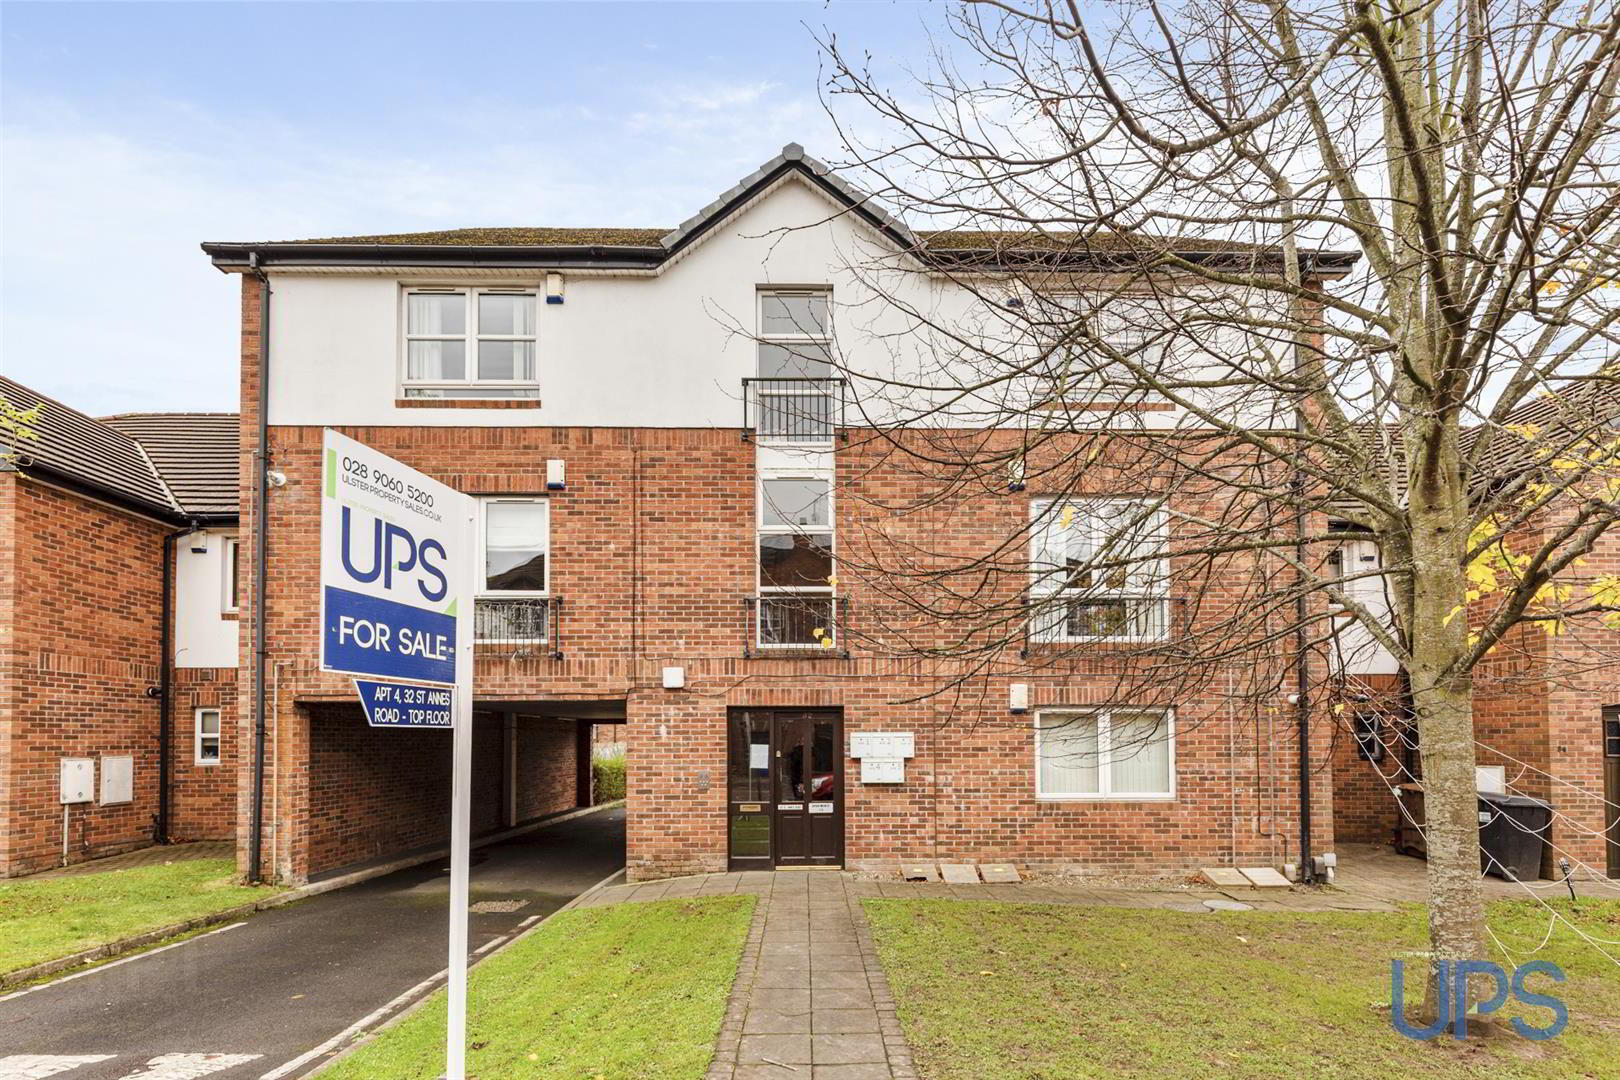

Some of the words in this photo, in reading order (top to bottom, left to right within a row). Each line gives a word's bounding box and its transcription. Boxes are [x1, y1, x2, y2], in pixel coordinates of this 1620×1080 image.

[342, 456, 368, 479] 028
[373, 469, 404, 494] 9060
[407, 484, 434, 508] 5200
[341, 505, 448, 602] UPS
[339, 615, 391, 652] FOR
[398, 627, 447, 660] SALE
[374, 686, 392, 702] APT
[403, 689, 415, 704] 32
[416, 690, 426, 704] ST
[427, 691, 451, 706] ANNES
[374, 707, 400, 723] ROAD
[408, 709, 425, 724] TOP
[426, 710, 451, 725] FLOOR
